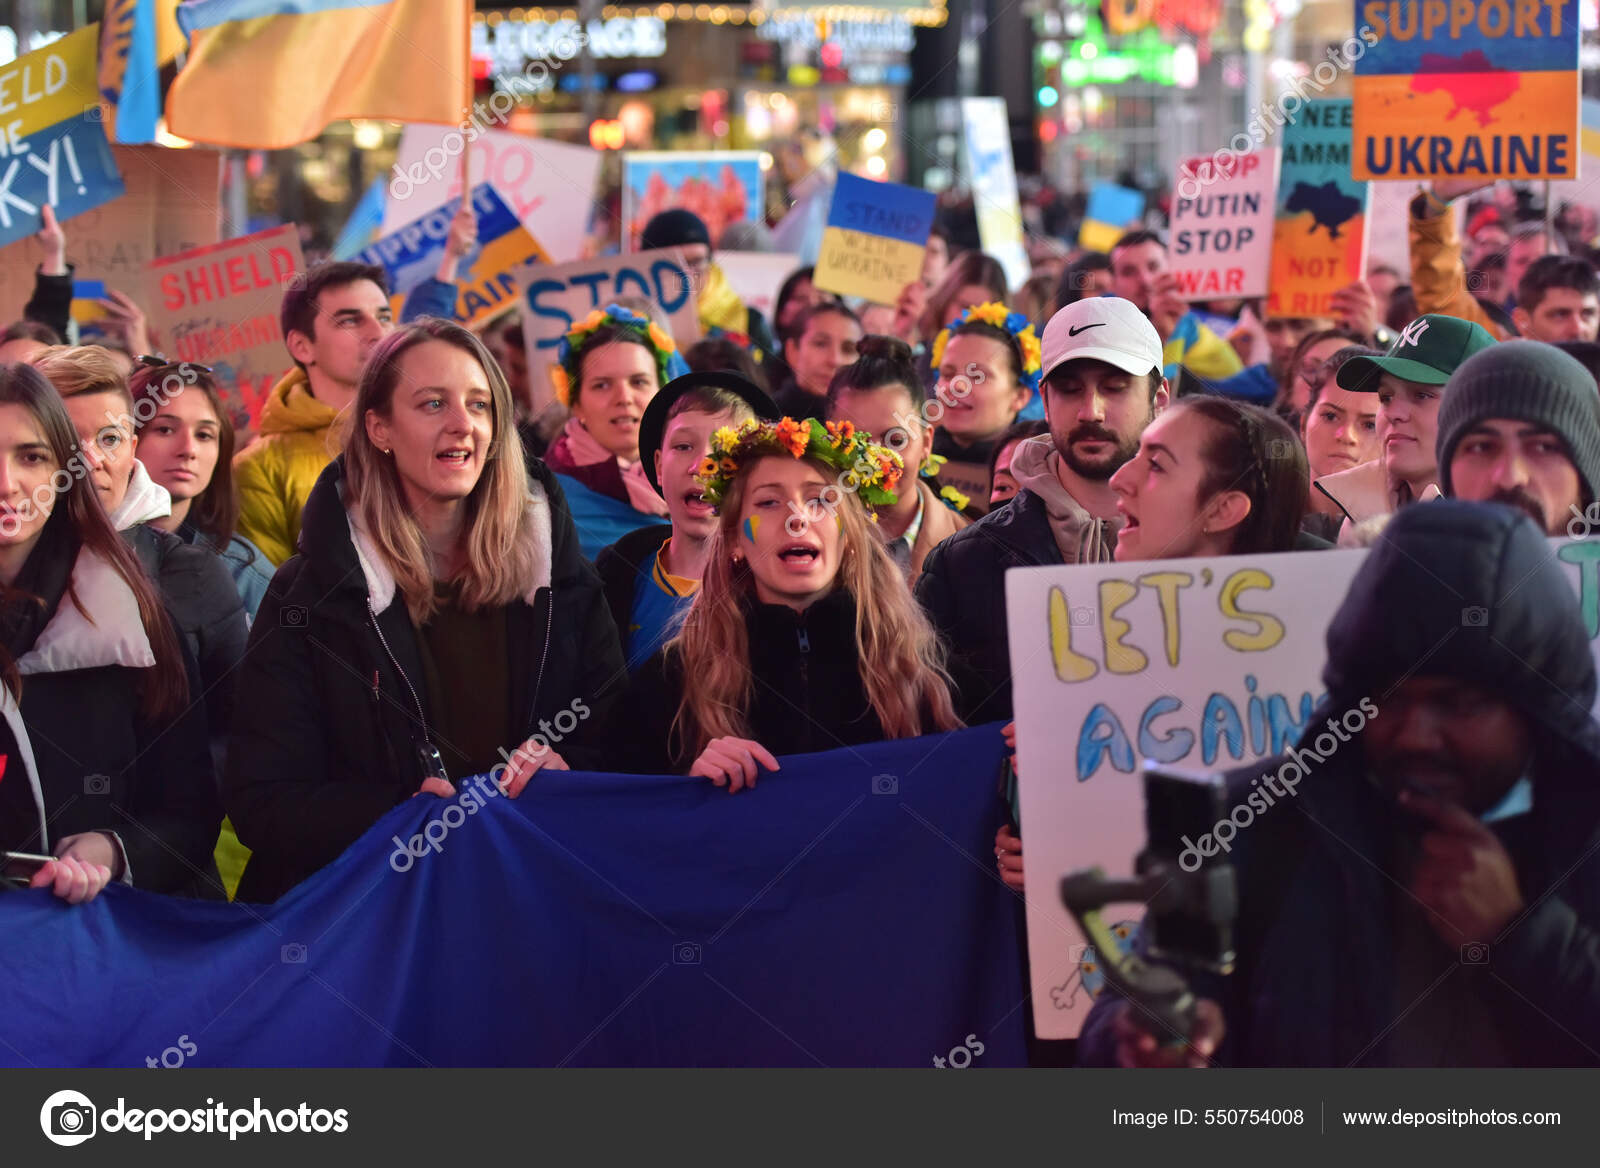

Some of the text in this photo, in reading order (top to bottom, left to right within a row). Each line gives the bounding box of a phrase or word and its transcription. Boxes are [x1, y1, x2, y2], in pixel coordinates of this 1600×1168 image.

[1364, 0, 1569, 41] SUPPORT
[1301, 104, 1353, 129] NEE
[1282, 142, 1350, 165] AMM
[1365, 135, 1569, 175] UKRAINE
[845, 202, 921, 234] STAND
[1176, 193, 1261, 219] PUTIN
[1176, 228, 1254, 255] STOP
[160, 246, 297, 313] SHIELD
[1175, 267, 1245, 294] WAR
[1288, 257, 1339, 279] NOT
[1048, 568, 1286, 683] LET'S
